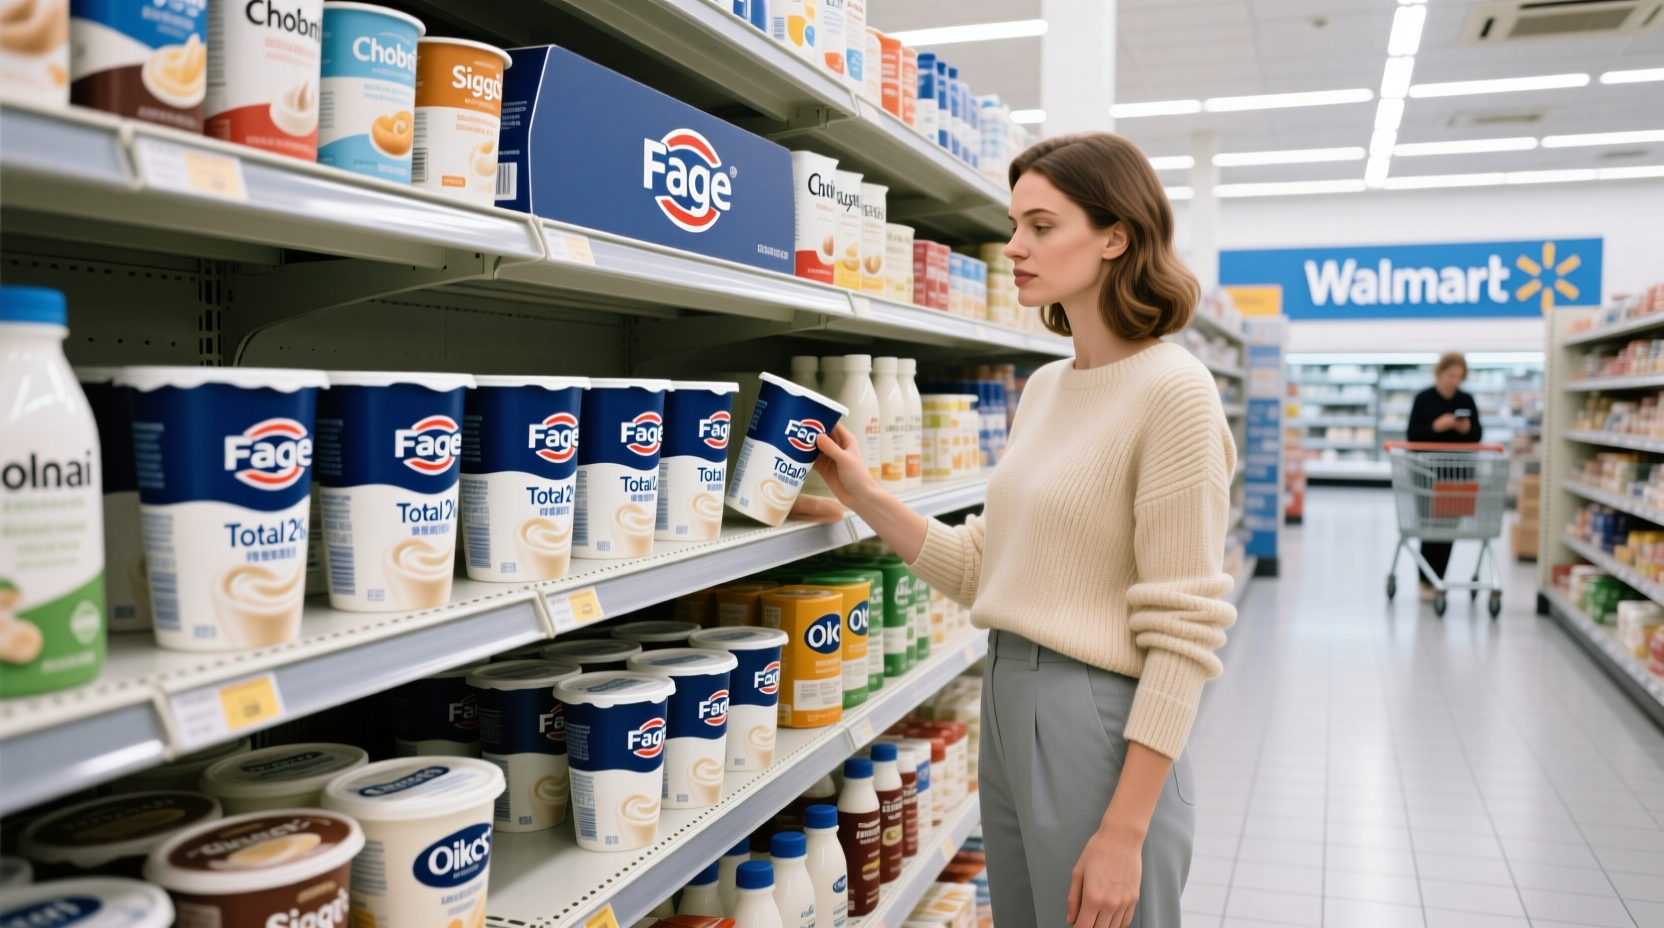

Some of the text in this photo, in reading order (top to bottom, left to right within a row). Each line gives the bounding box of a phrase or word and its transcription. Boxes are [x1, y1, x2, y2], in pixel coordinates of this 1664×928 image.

[643, 137, 732, 218] Fage
[1304, 253, 1511, 306] Walmart
[528, 424, 579, 453] Fage
[699, 418, 730, 442] Fag
[224, 435, 313, 474] Fage
[395, 429, 462, 463] Fage
[774, 456, 802, 479] Total
[526, 486, 564, 505] Total
[620, 476, 652, 492] Total
[396, 501, 443, 523] Total
[224, 520, 284, 548] Total
